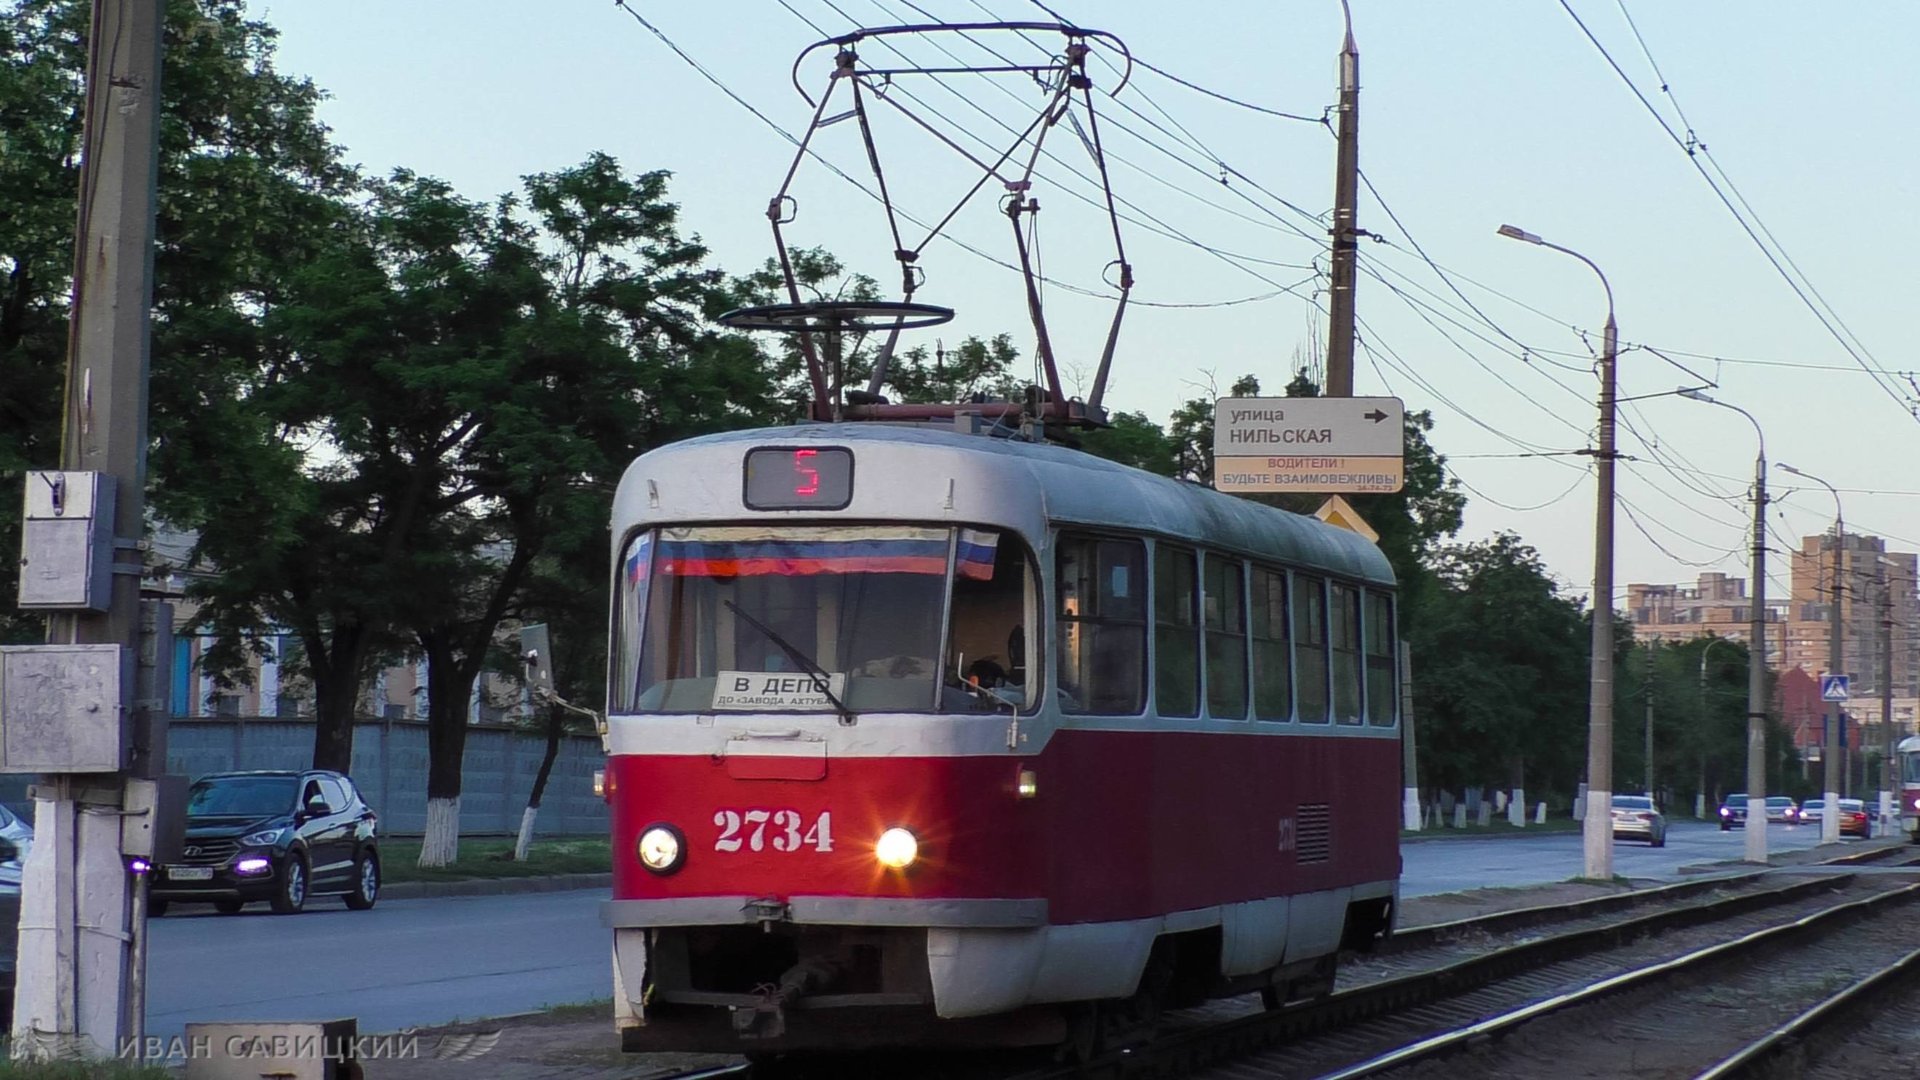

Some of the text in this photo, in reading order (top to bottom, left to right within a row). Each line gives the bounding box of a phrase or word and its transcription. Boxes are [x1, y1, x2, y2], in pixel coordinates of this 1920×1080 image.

[1230, 409, 1285, 424] улица
[1229, 429, 1332, 443] НИЛЬСКАЯ
[1267, 458, 1338, 469] ВОДИТЕЛИ
[795, 449, 818, 494] 5
[1223, 474, 1397, 485] БУДЬТЕ ВЗАИМОВЕЖЛИВЫ
[734, 677, 831, 695] В ДЕПО
[718, 696, 734, 705] ДО
[713, 810, 835, 852] 2734
